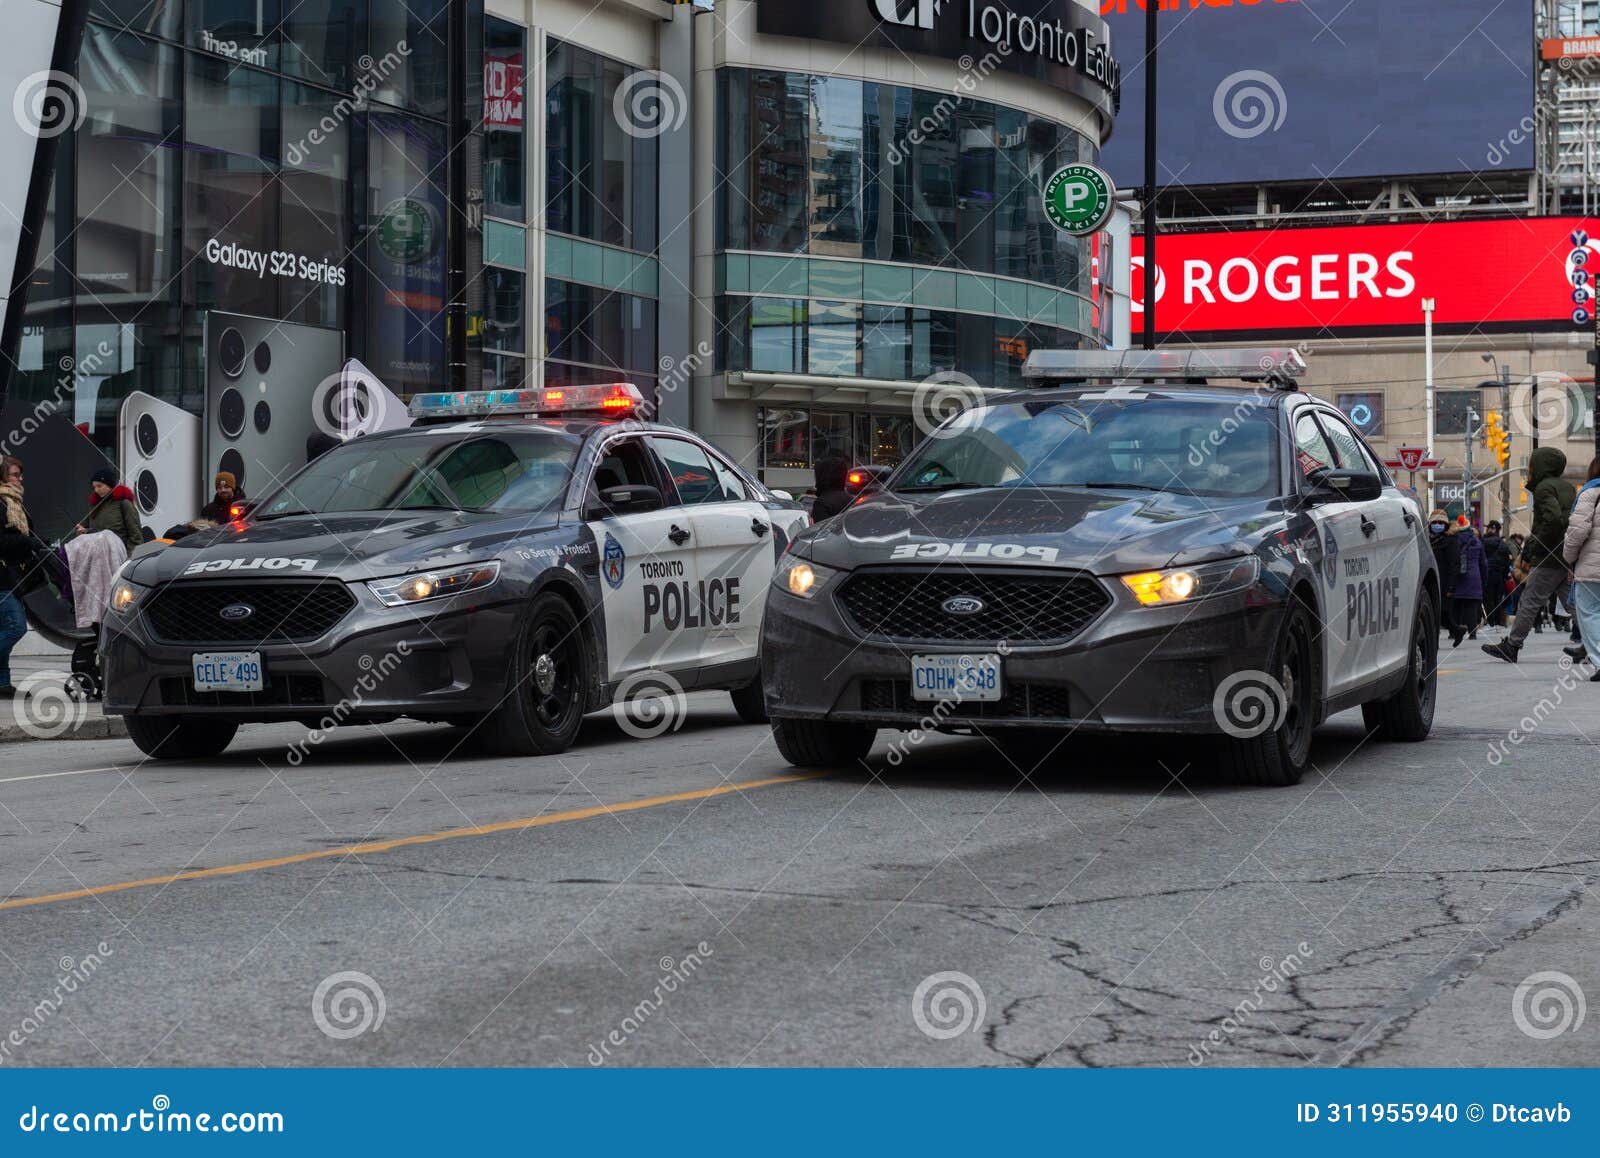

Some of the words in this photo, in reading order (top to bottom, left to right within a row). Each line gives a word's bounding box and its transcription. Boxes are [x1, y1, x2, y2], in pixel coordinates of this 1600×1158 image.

[969, 0, 1078, 67] Toronto
[1085, 28, 1119, 91] Eato
[1048, 168, 1103, 194] MUNICIPAL
[1064, 182, 1089, 209] P
[1048, 201, 1105, 229] PARKING
[206, 238, 268, 279] Galaxy
[270, 250, 296, 277] S23
[298, 255, 346, 286] Series
[1183, 251, 1415, 304] ROGERS
[516, 550, 531, 560] To
[529, 548, 555, 558] Serve
[562, 543, 591, 555] Protect
[640, 560, 684, 579] TORONTO
[1343, 556, 1370, 577] TORONTO
[643, 576, 740, 634] POLICE
[950, 601, 975, 611] Ford
[1346, 576, 1400, 641] POLICE
[196, 663, 228, 683] CELE
[236, 662, 259, 681] 499
[916, 667, 955, 690] CDHW
